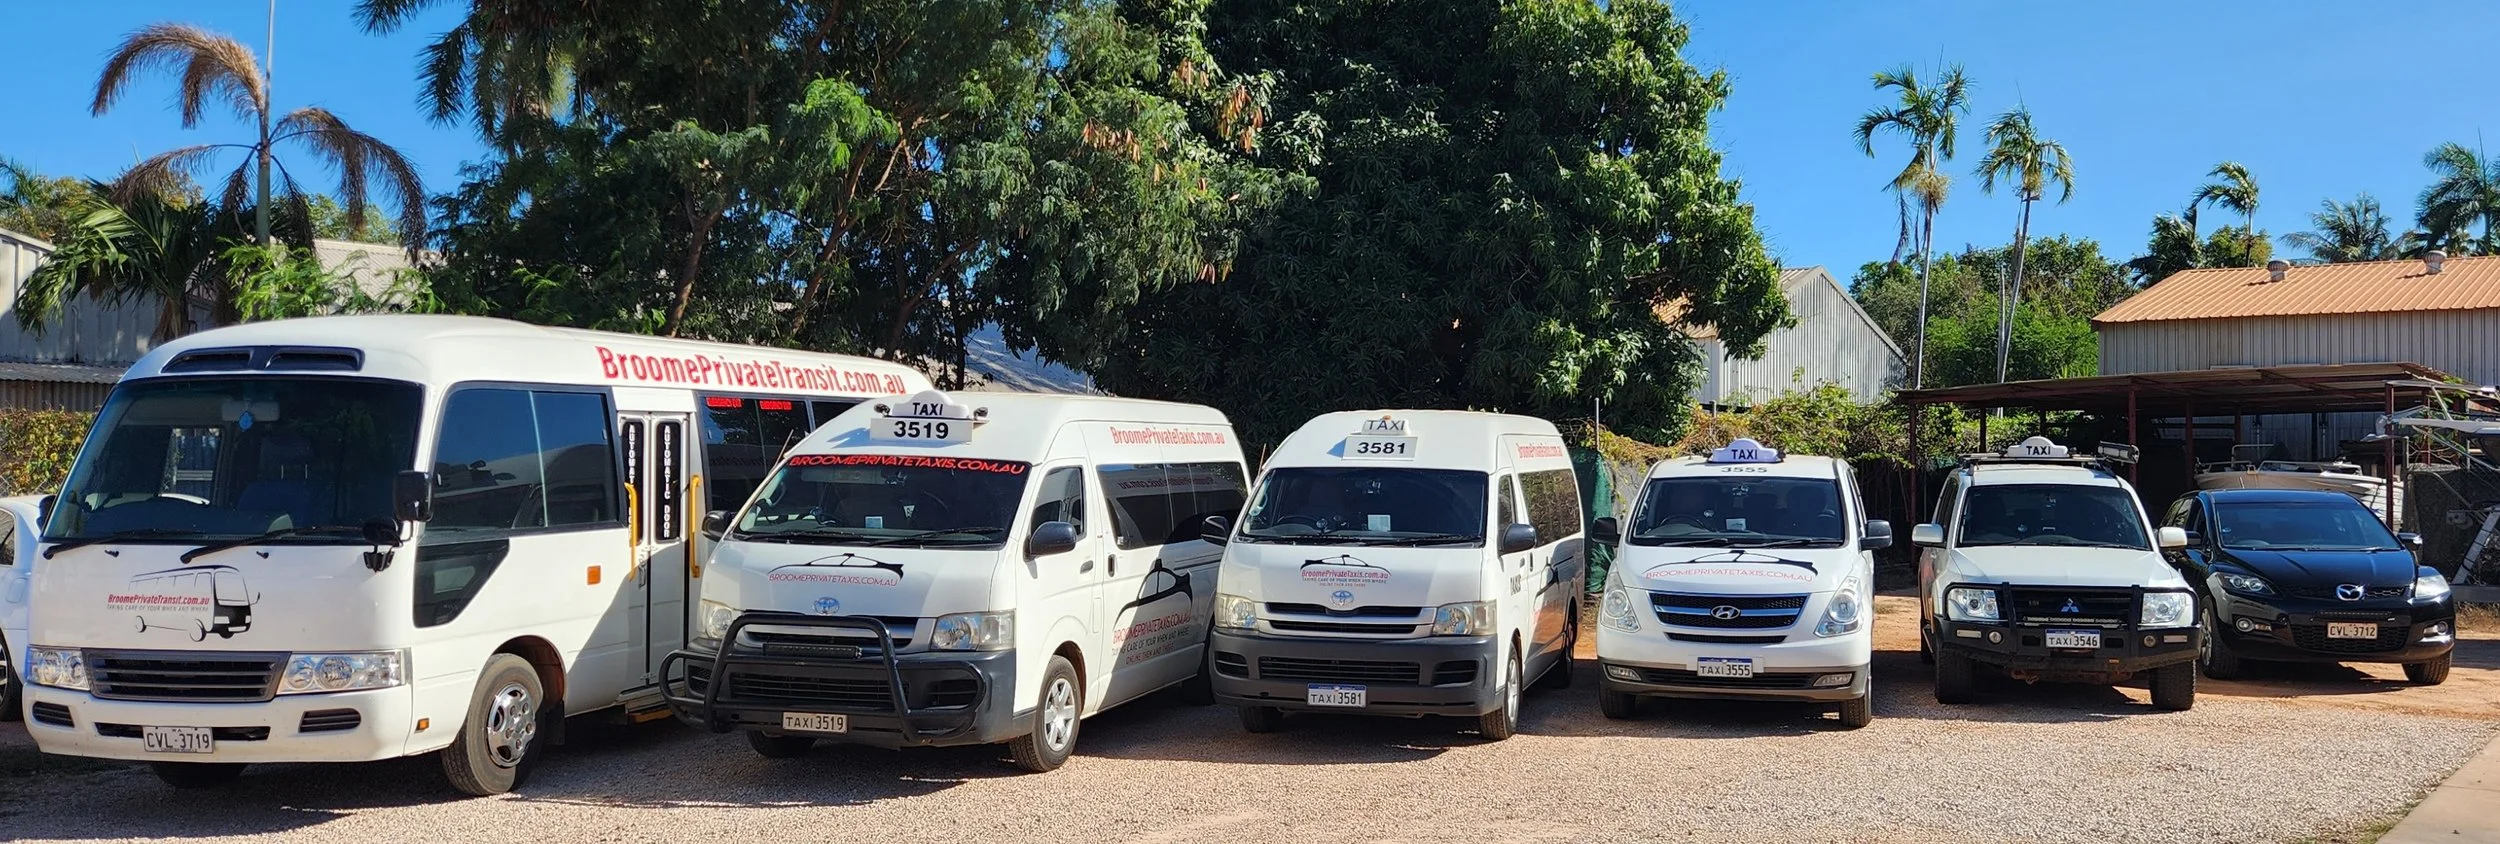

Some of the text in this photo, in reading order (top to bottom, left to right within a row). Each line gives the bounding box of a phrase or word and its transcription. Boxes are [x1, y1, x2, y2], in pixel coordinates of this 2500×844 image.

[594, 346, 906, 394] BroomePrivateTransit.com.au
[912, 402, 944, 416] TAXI
[893, 421, 949, 439] 3519
[1366, 420, 1406, 431] TAXI
[1110, 426, 1225, 444] BroomePrivateTaxis.com.au
[1357, 442, 1406, 454] 3581
[1731, 449, 1758, 459] TAXI
[2026, 446, 2051, 455] TAXI
[628, 424, 636, 499] AUTOMAT
[789, 455, 1026, 475] BROOMEPRIVATETAXIS.COM.AU
[663, 425, 671, 538] AUTOMATIC DOOR
[769, 573, 898, 587] BROOMEPRIVATETAXIS.COM.AU
[1646, 569, 1813, 582] BROOMEPRIVATETAXIS.COM.AU
[107, 594, 210, 605] BroomePrivateTransit.com.au
